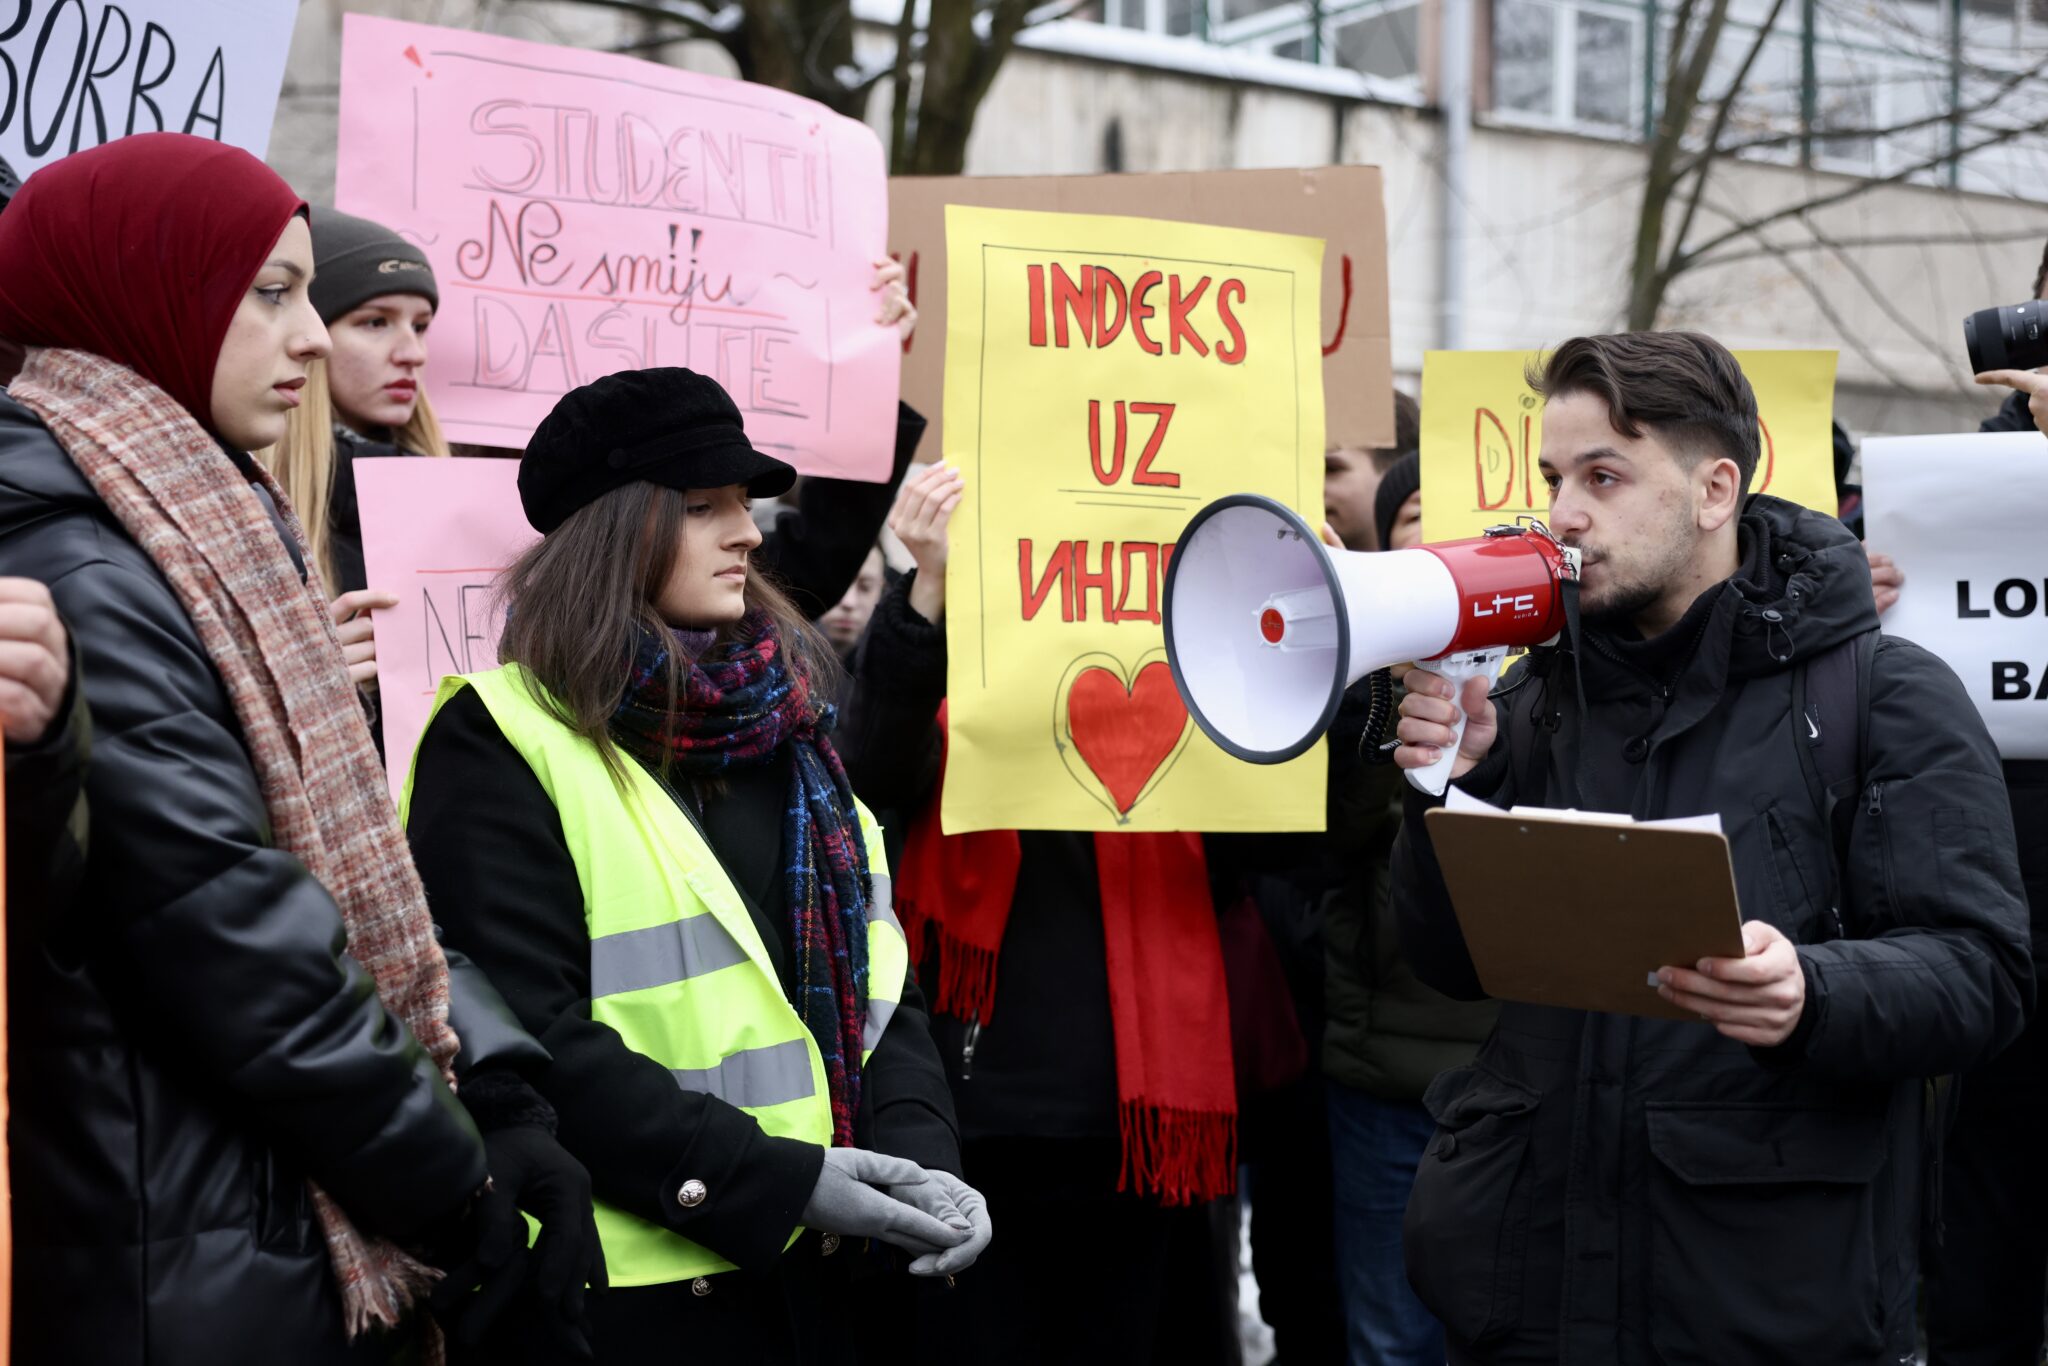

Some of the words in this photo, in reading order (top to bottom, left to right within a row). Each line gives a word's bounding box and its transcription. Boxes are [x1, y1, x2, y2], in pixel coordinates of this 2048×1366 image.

[471, 98, 820, 230] STUDENTI
[456, 197, 575, 287] Ne
[1026, 262, 1248, 366] INDEKS
[1088, 400, 1182, 489] UZ
[1018, 538, 1178, 625] ИНД
[1956, 577, 2048, 619] LO
